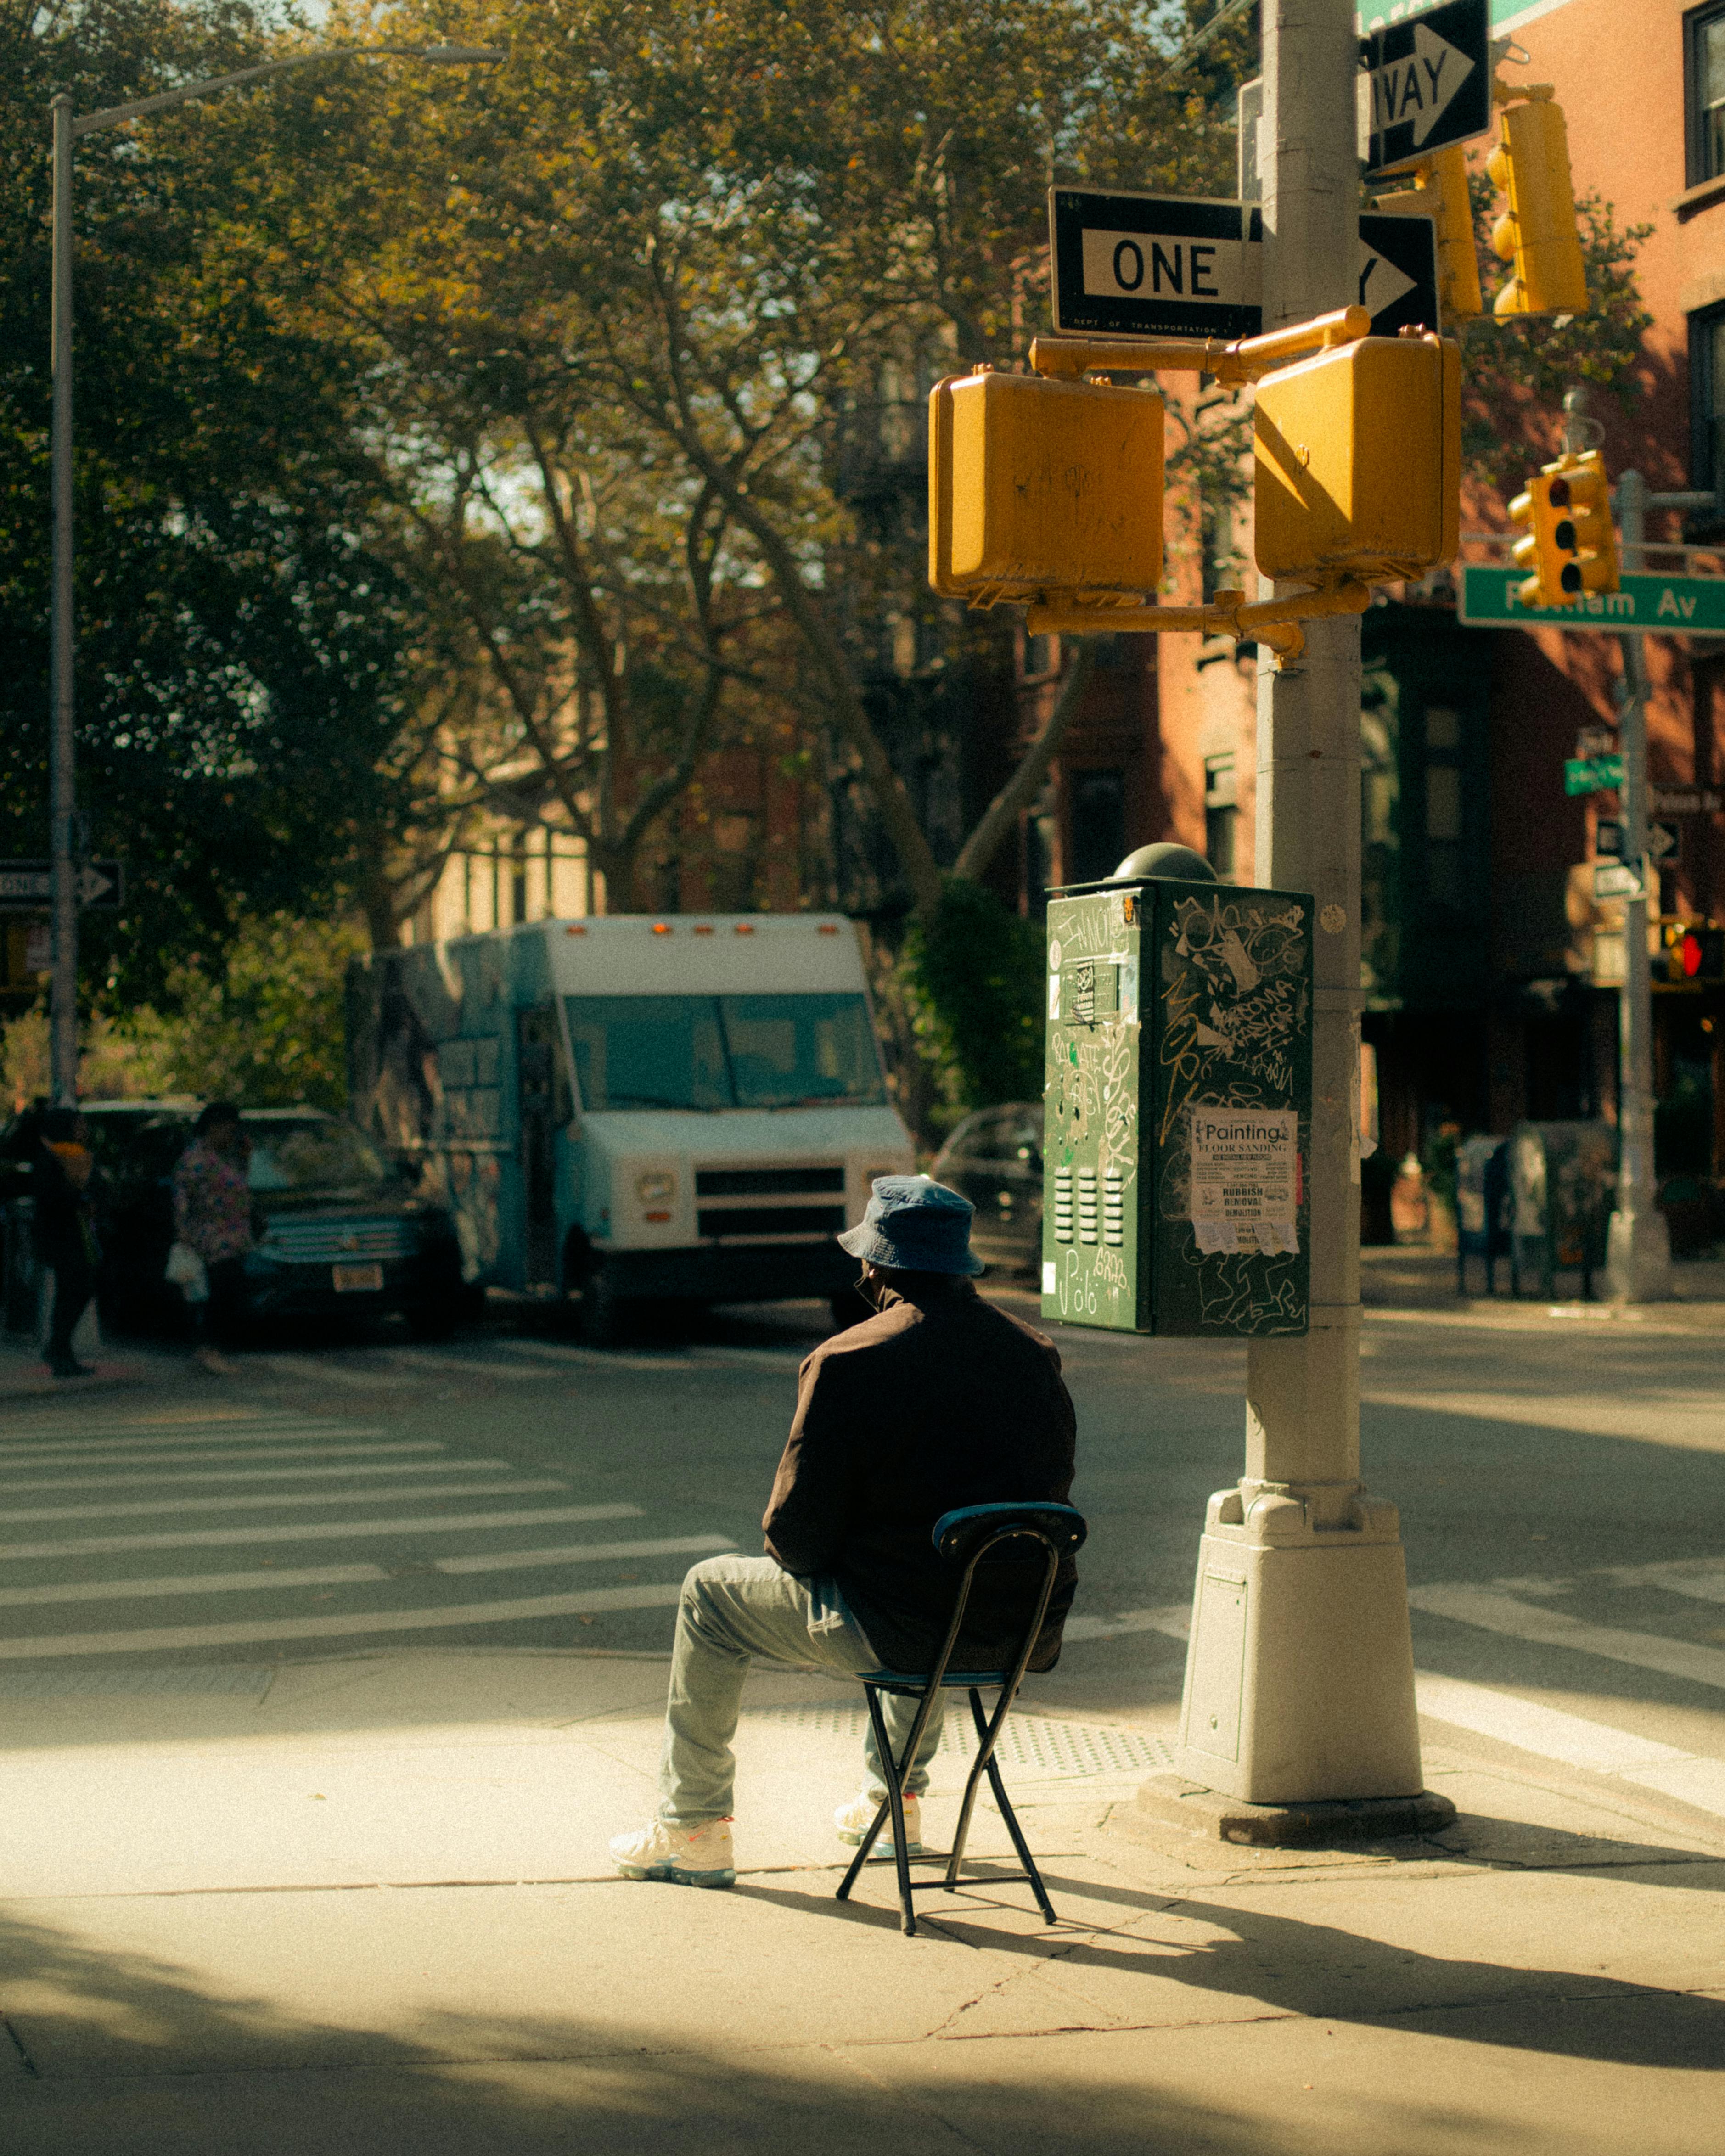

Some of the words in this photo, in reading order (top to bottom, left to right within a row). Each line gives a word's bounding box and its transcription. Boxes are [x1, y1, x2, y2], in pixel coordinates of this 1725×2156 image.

[1113, 239, 1219, 296] ONE
[1131, 322, 1218, 334] TRANSPORTATION
[1657, 589, 1697, 618] Av
[1206, 1124, 1280, 1143] Painting
[1198, 1144, 1236, 1152] FLOOR
[1239, 1144, 1286, 1152] SANDING
[1225, 1198, 1262, 1206] REMOVAL
